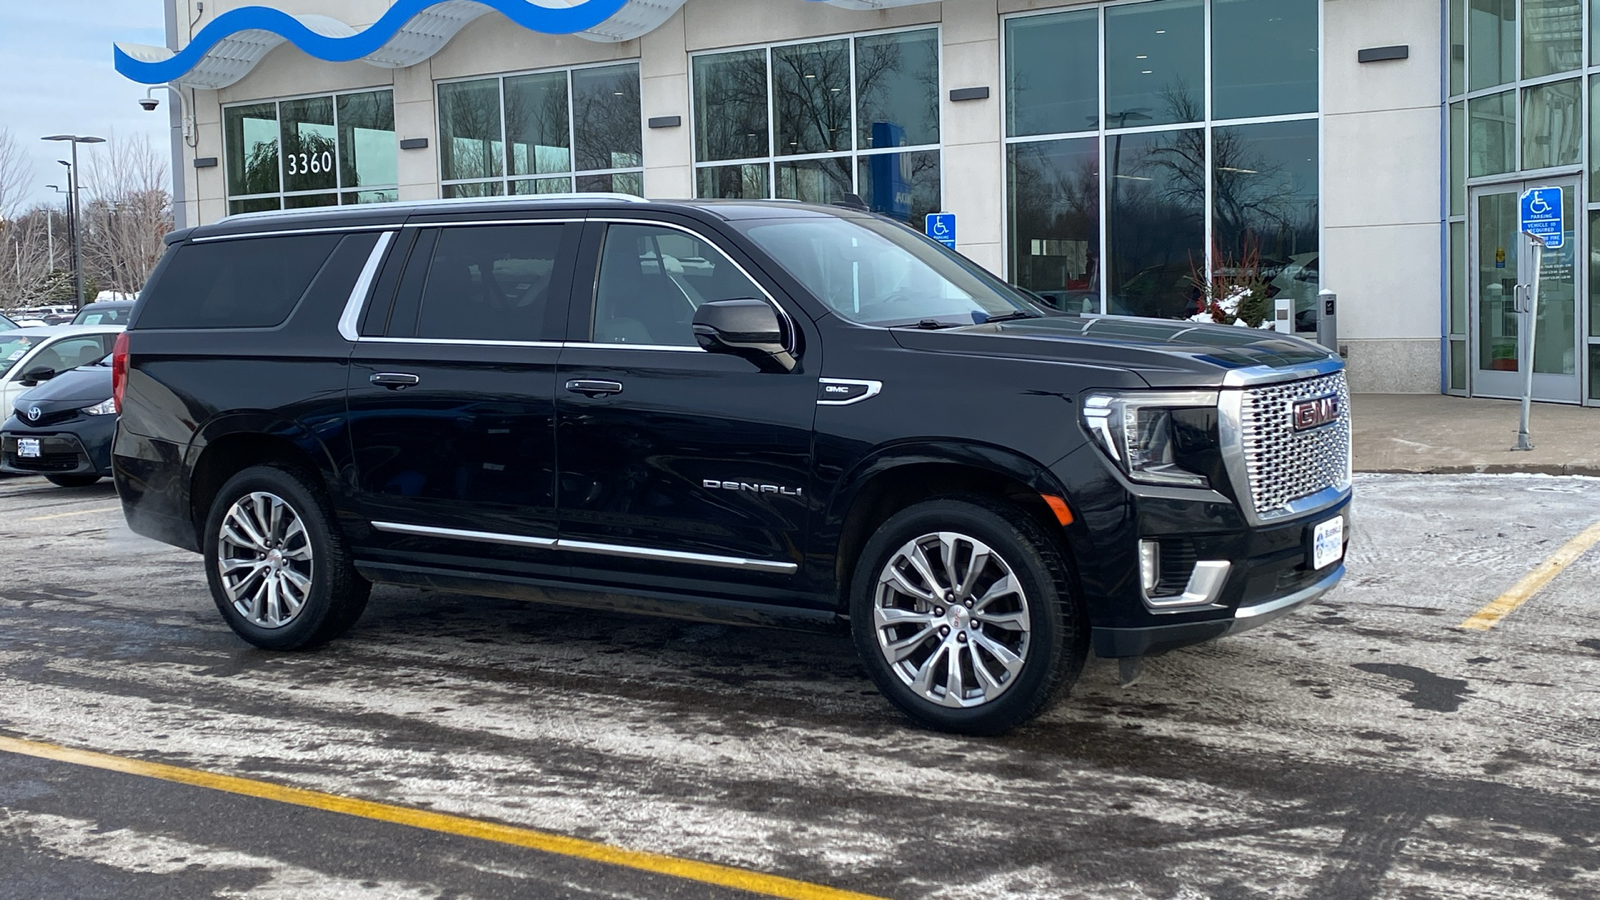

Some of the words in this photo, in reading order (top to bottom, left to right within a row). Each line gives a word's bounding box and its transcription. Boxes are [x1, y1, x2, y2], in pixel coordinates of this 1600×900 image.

[288, 151, 332, 175] 3360
[825, 385, 849, 393] GMC
[1294, 398, 1340, 430] GMC
[702, 478, 802, 496] DENALI
